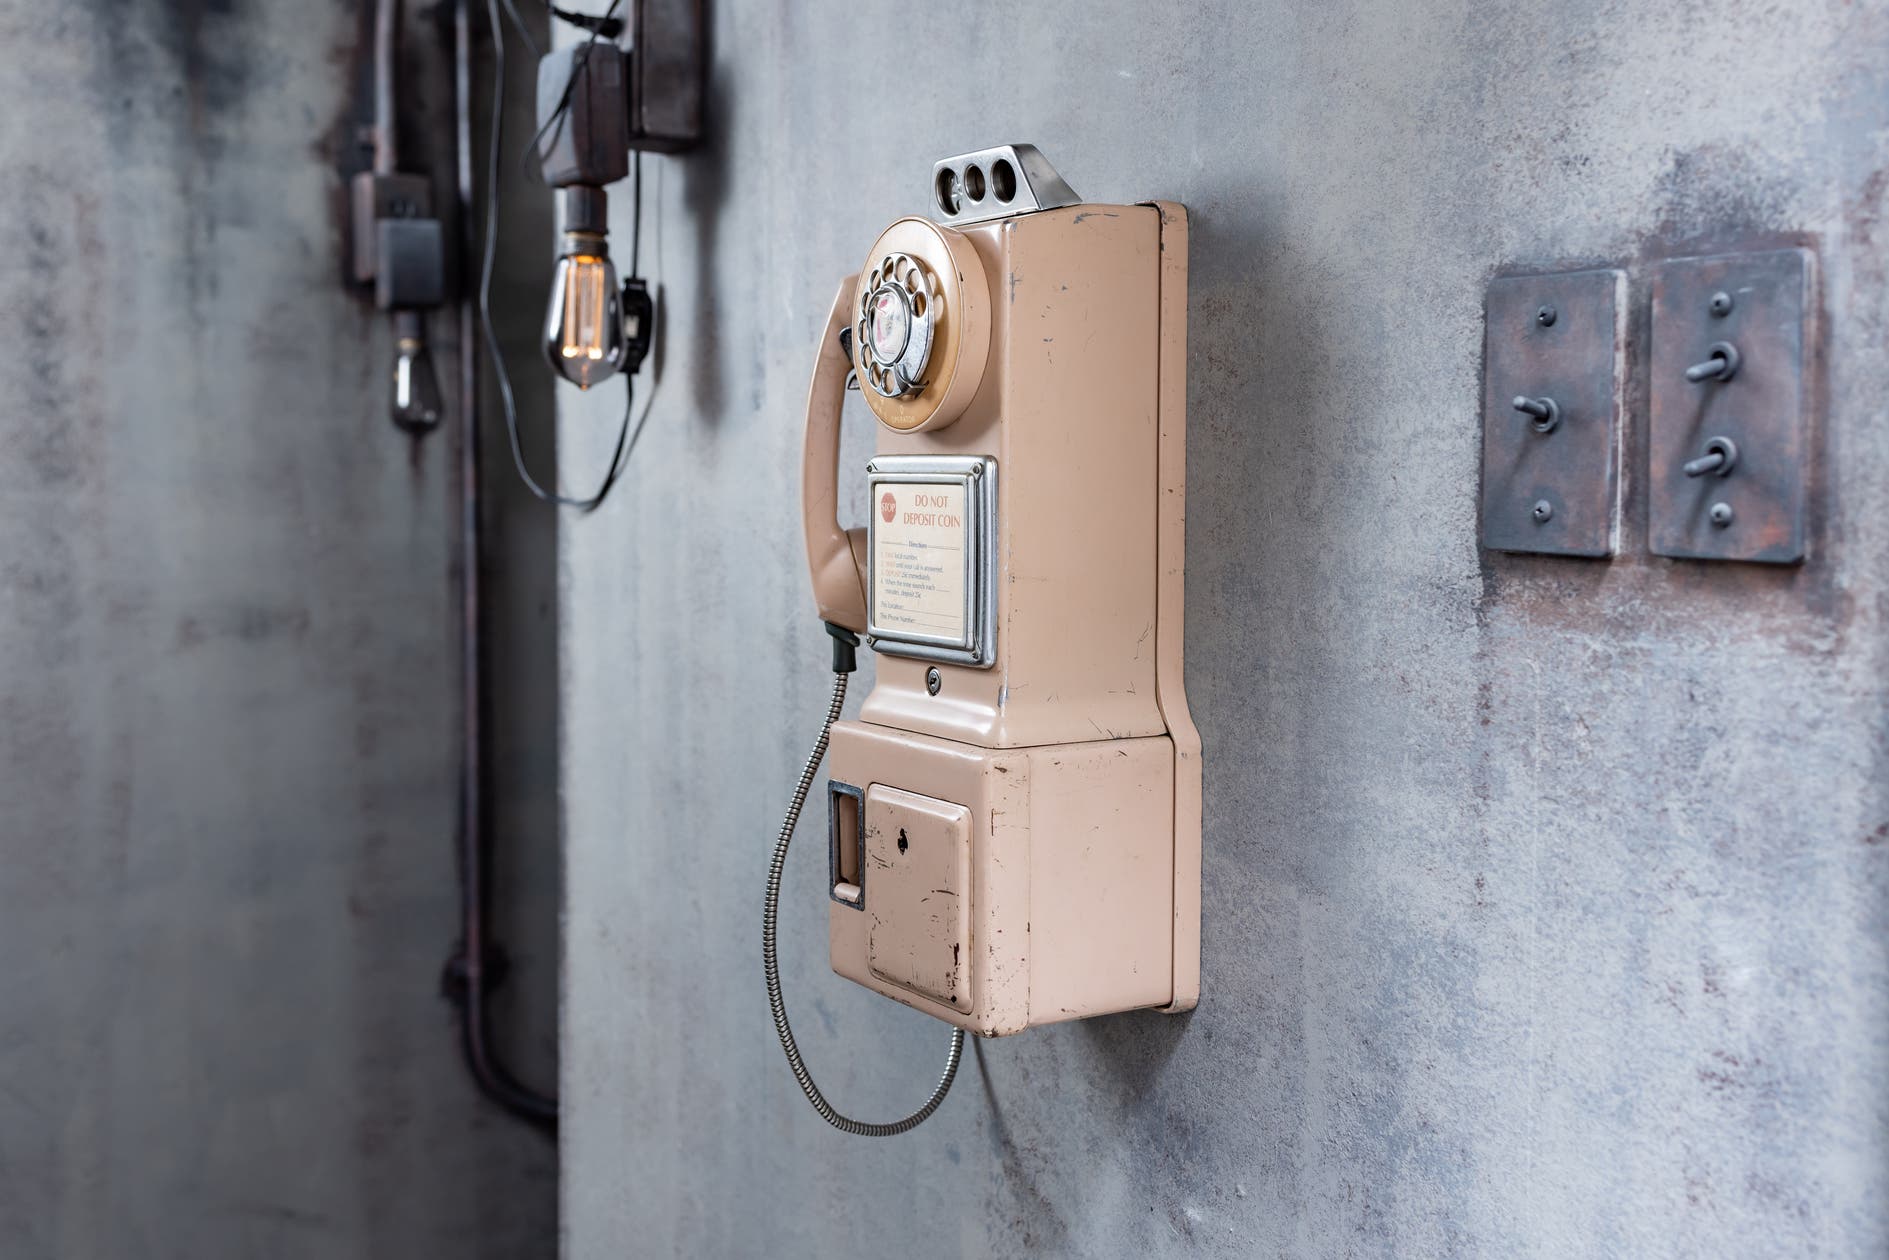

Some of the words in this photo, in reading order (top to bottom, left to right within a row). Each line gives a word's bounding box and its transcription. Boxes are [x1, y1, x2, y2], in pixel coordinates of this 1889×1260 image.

[881, 502, 896, 512] STOP
[915, 494, 928, 507] DO
[930, 495, 948, 508] NOT
[903, 512, 936, 526] DEPOSIT
[938, 514, 960, 528] COIN
